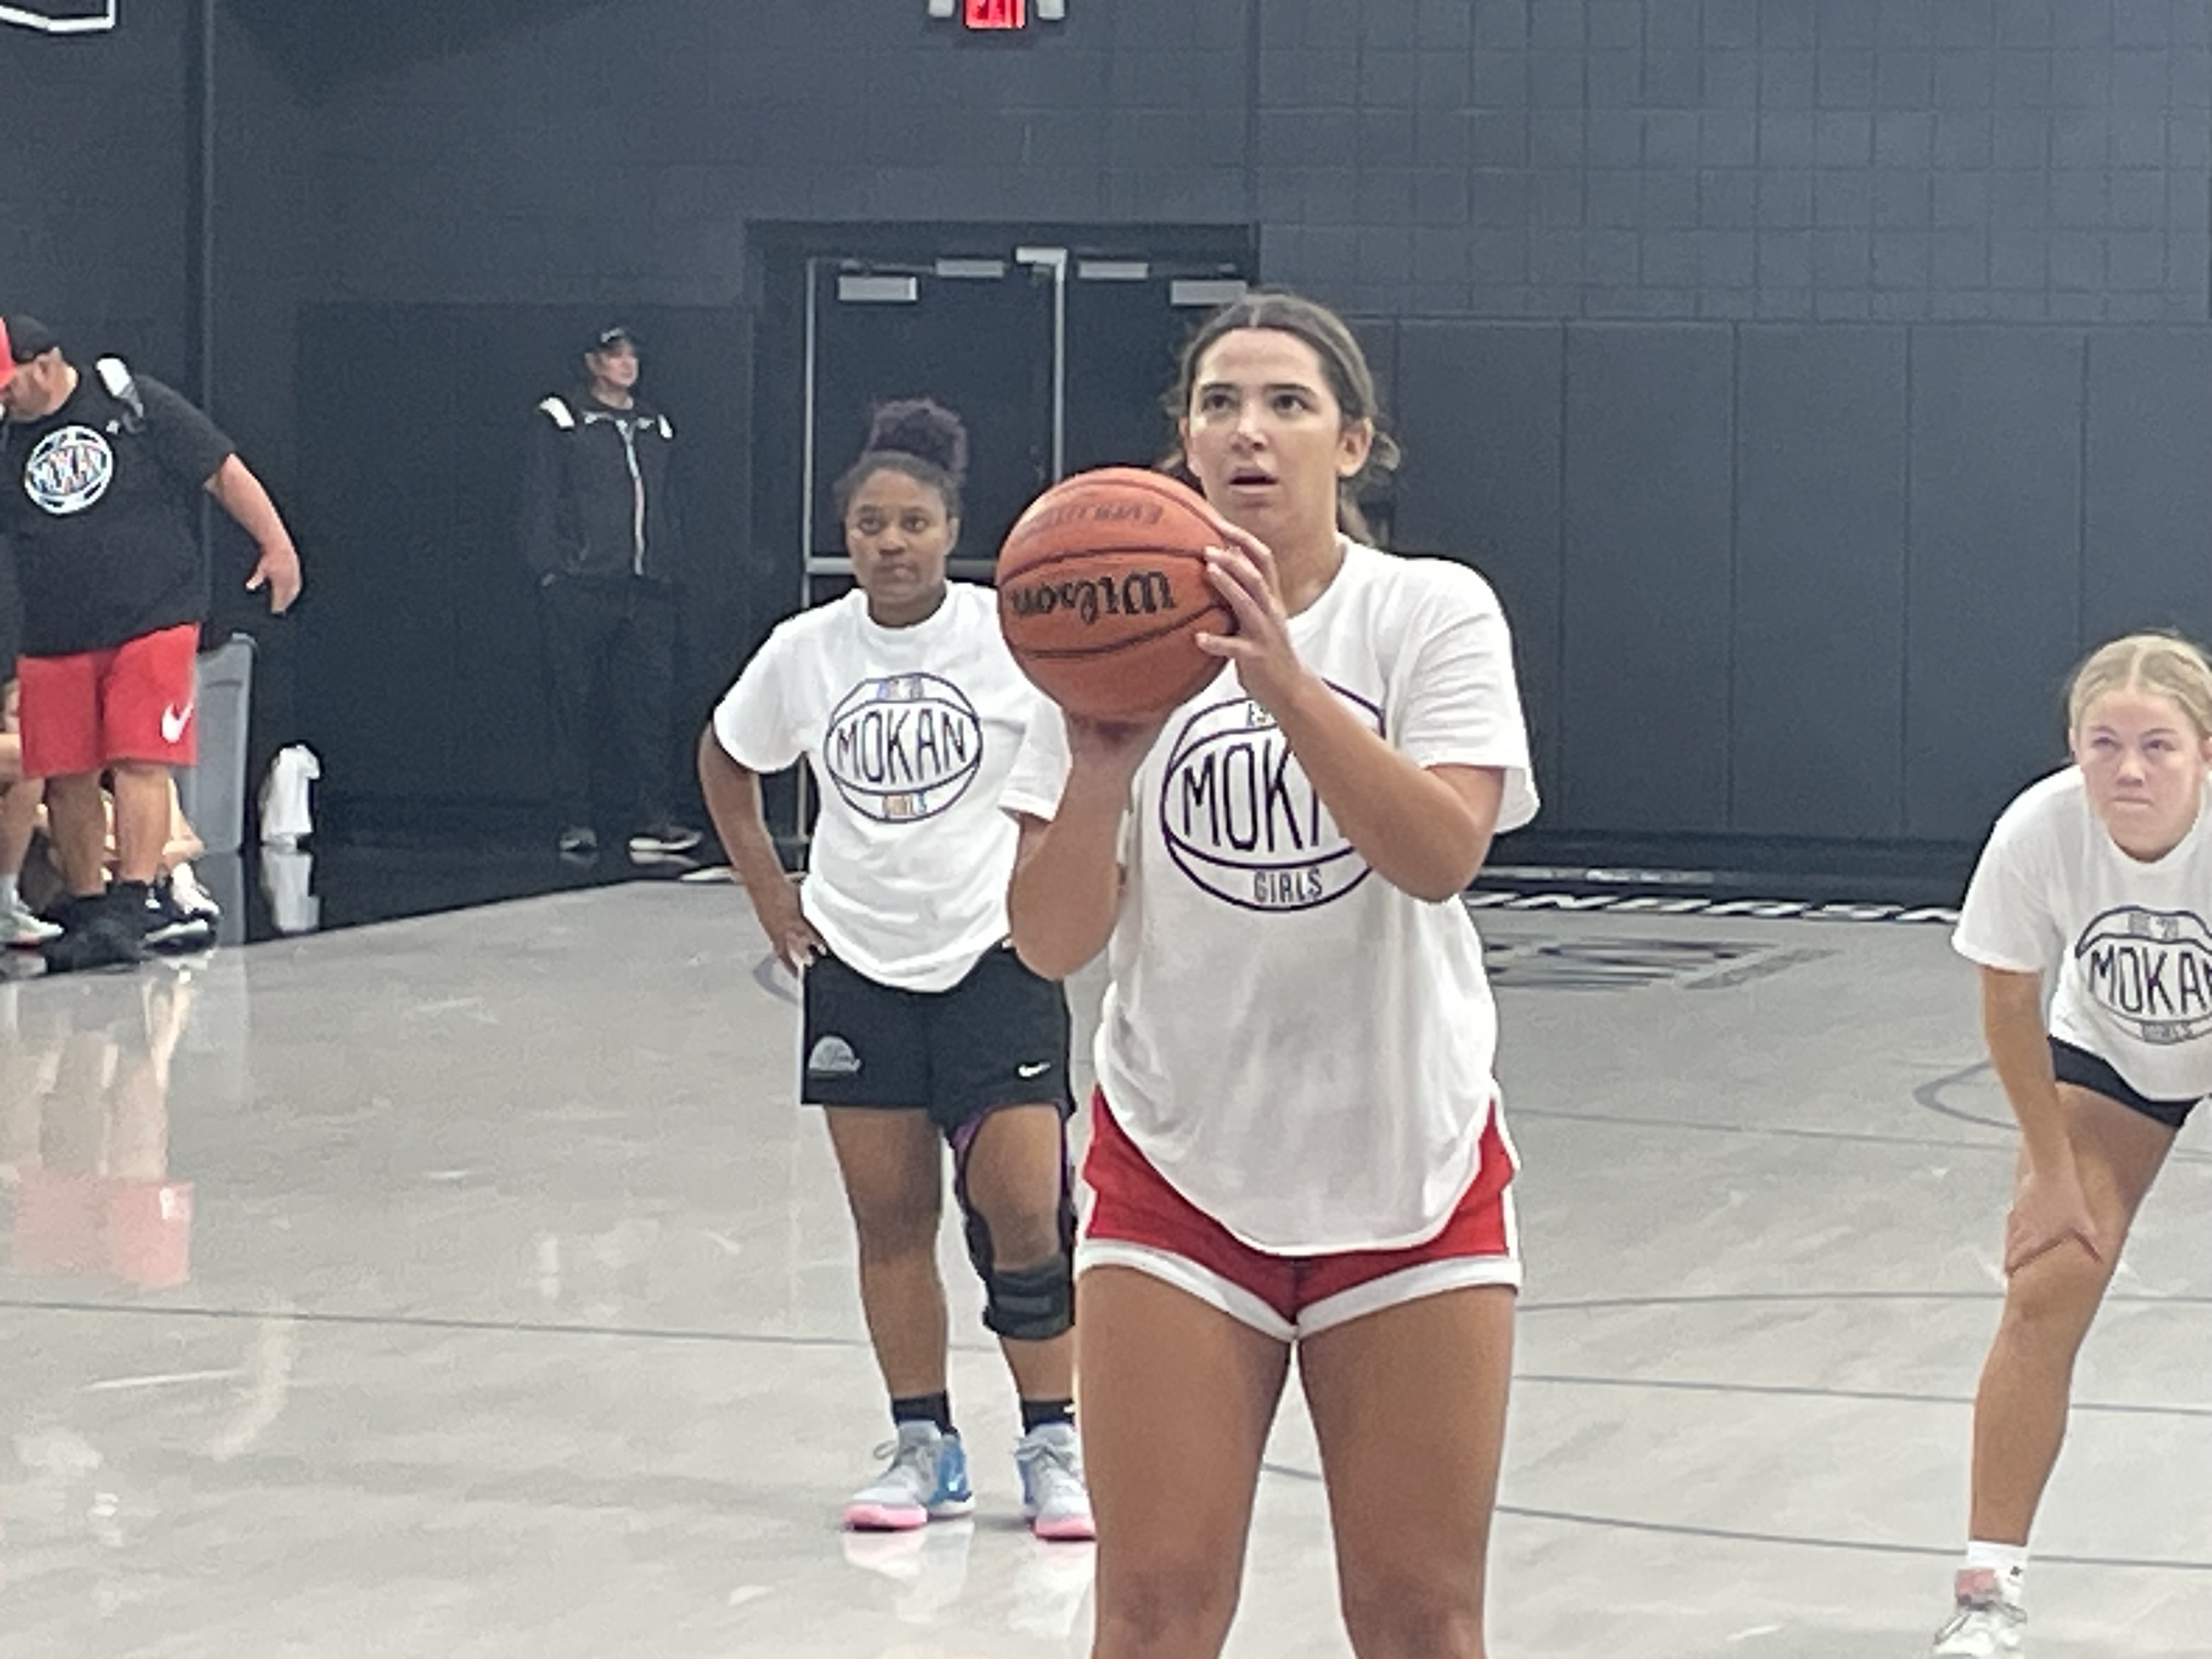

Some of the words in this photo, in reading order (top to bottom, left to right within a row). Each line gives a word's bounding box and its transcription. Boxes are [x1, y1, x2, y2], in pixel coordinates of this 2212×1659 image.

[1011, 571, 1175, 625] Wilson
[837, 708, 966, 785] MOKAN
[1182, 738, 1320, 853] MOK
[1254, 866, 1322, 903] GIRLS
